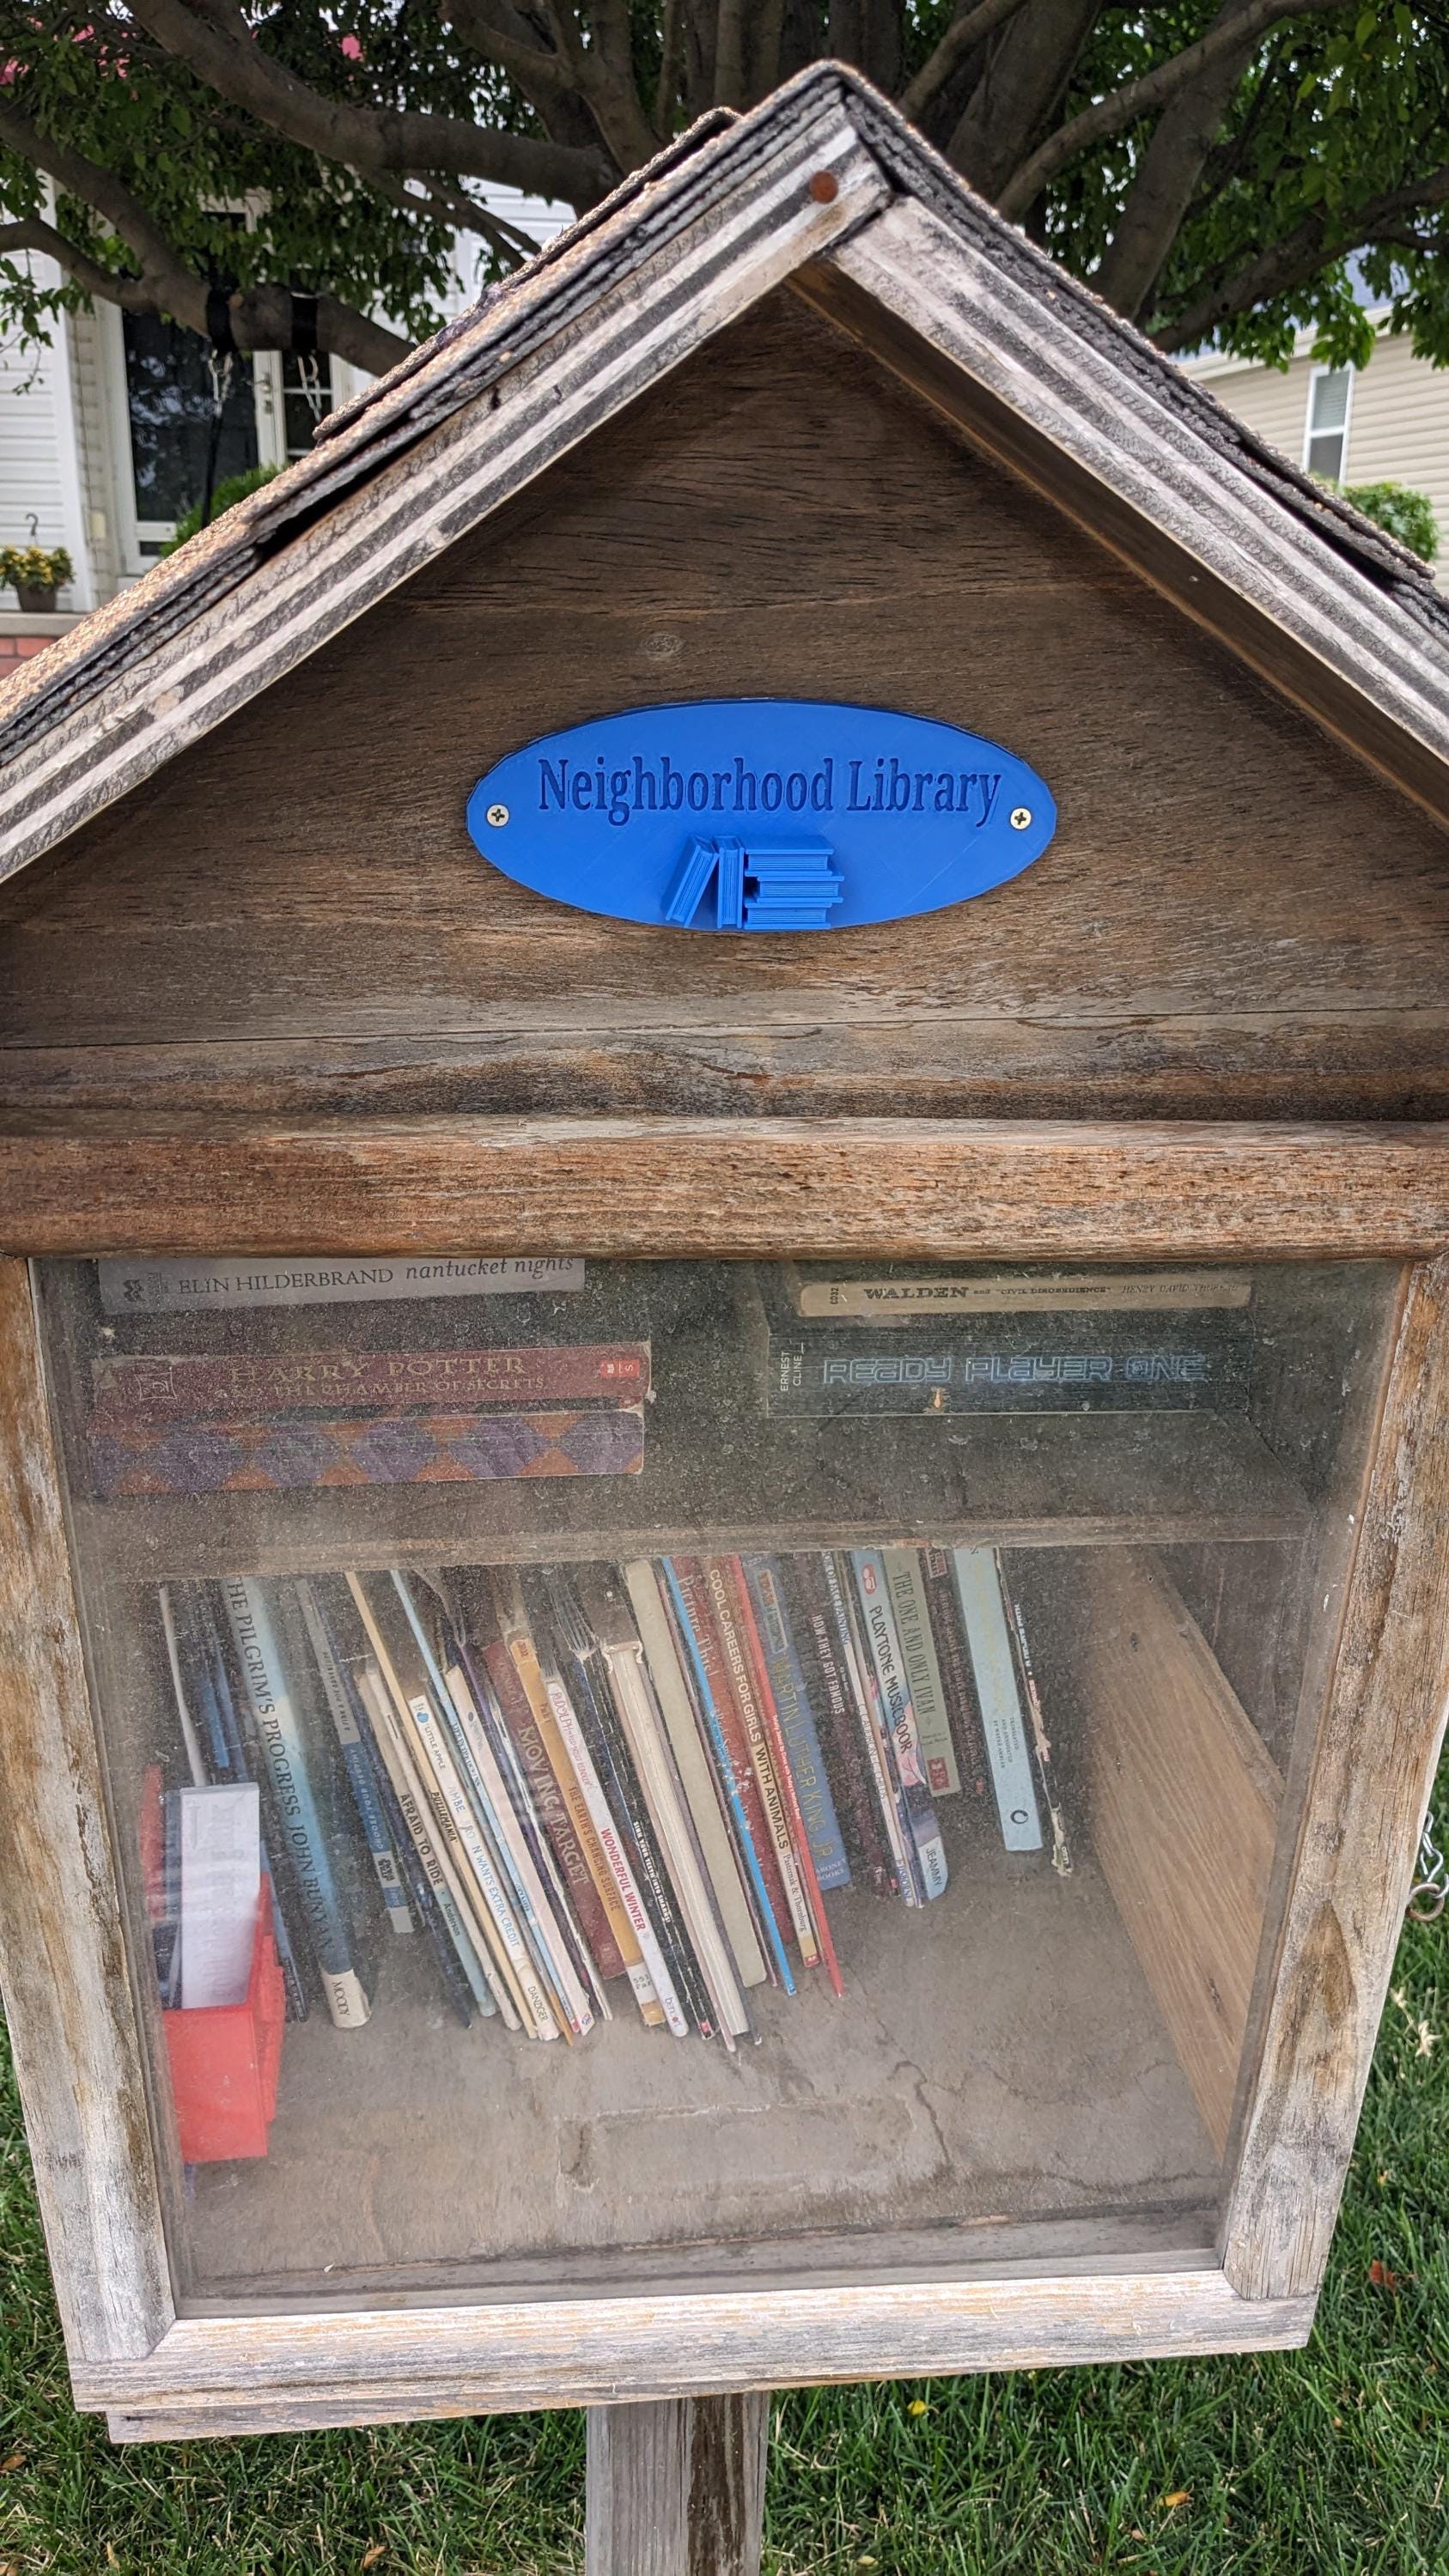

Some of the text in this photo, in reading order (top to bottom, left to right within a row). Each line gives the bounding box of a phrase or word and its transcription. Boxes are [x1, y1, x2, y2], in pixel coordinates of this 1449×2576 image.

[538, 756, 1002, 828] Neighborhood Library
[178, 1277, 229, 1294] ELIN
[236, 1268, 393, 1291] HILDERBRAND
[405, 1258, 508, 1280] nantucket
[514, 1256, 574, 1279] nights
[863, 1286, 970, 1300] WALDEN
[230, 1357, 529, 1382] HARRY POTTER
[321, 1382, 427, 1395] CHAMBER
[435, 1381, 460, 1391] OF
[467, 1376, 545, 1390] SECRETS
[780, 1350, 790, 1392] ERNEST
[792, 1354, 803, 1387] CLINE
[823, 1354, 1207, 1384] READY PLAYER ONE
[676, 1575, 703, 1633] Picture
[707, 1568, 728, 1610] COOL
[891, 1571, 915, 1599] THE
[833, 1606, 853, 1645] PAINTING
[895, 1598, 919, 1624] ONE
[717, 1609, 745, 1674] CAREERS
[866, 1606, 895, 1674] PLAYTONE
[901, 1625, 925, 1652] AND
[811, 1614, 846, 1715] HOW THEY GOT FAMOUS
[905, 1652, 931, 1683] ONLY
[734, 1674, 752, 1704] FOR
[771, 1658, 800, 1722] MARTIN
[912, 1685, 937, 1716] IVAN
[234, 1612, 277, 1715] PILGRIM'S
[261, 1716, 302, 1817] PROGRESS
[551, 1690, 573, 1731] RUDOLPH
[741, 1703, 762, 1743] GIRLS
[423, 1725, 446, 1771] LITTLE APPLE
[754, 1747, 774, 1784] WITH
[783, 1721, 817, 1789] LUTHER
[359, 1787, 373, 1812] YOUR
[516, 1724, 590, 1888] MOVING TARGET
[763, 1785, 790, 1850] ANIMALS
[800, 1789, 831, 1832] KING
[368, 1814, 384, 1850] CHOOSE
[399, 1792, 444, 1886] AFRAID TO RIDE
[568, 1785, 621, 1912] THE EARTH'S CHANGING SURFACE
[288, 1823, 335, 1953] JOHN BUNYAN
[600, 1826, 647, 1931] WONDERFUL WINTER
[631, 1820, 673, 1923] SINK YOUR TEETH INTO SHARKS!
[474, 1855, 495, 1886] WANTS
[486, 1886, 508, 1917] EXTRA
[498, 1915, 521, 1948] CREDIT
[782, 1853, 797, 1886] Pasternak
[792, 1895, 807, 1932] Thornburg
[442, 1901, 463, 1936] Anderson
[330, 1979, 351, 2018] MOODY
[527, 1984, 548, 2021] DANZIGER
